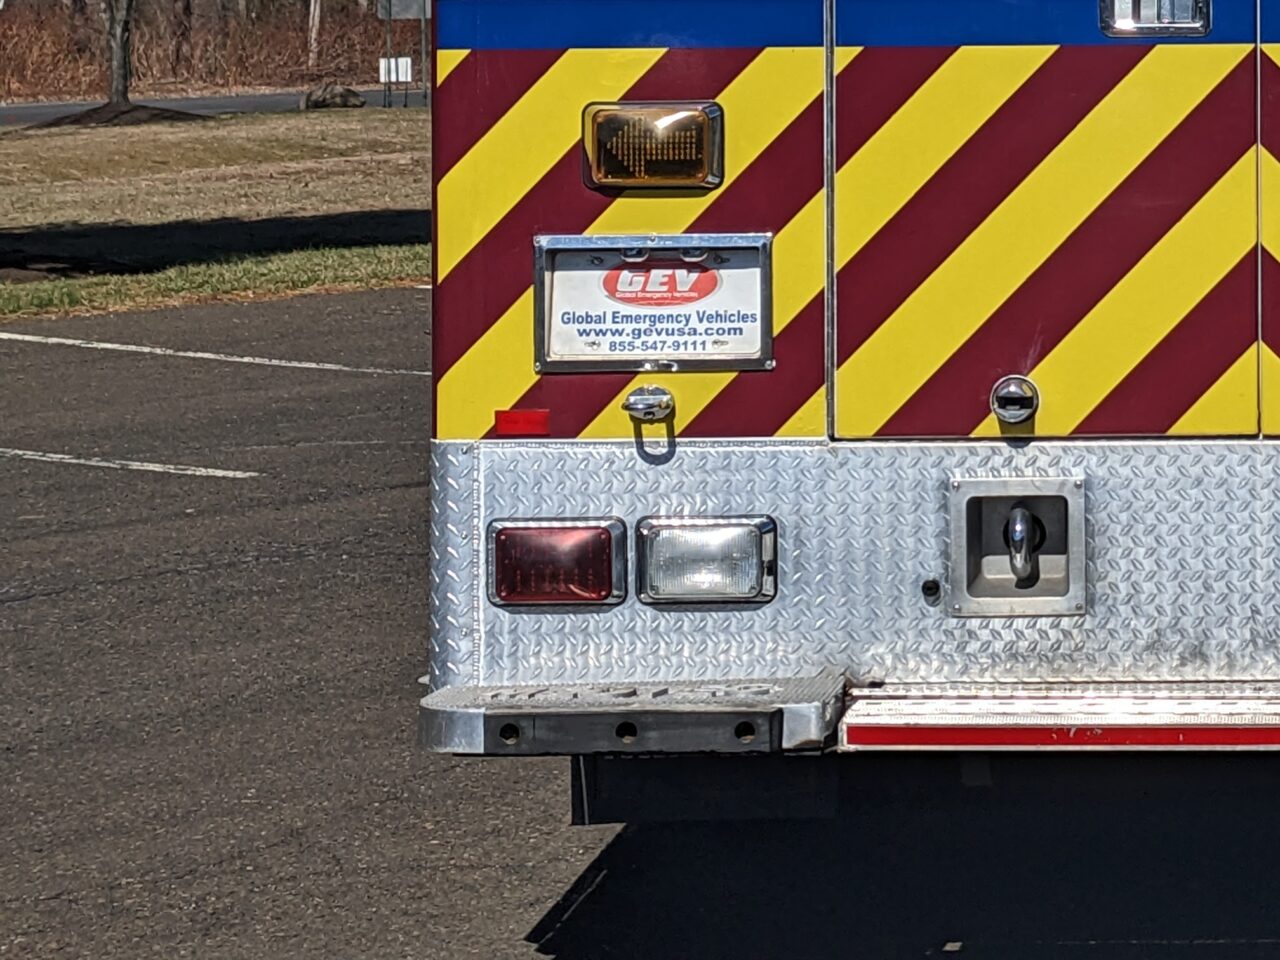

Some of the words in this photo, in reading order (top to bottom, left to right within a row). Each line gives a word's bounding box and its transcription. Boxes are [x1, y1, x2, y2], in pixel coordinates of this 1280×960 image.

[616, 268, 700, 291] GEV
[561, 310, 606, 325] Global
[611, 310, 691, 327] Emergency
[696, 309, 758, 324] Vehicles
[576, 326, 744, 339] www.gevusa.com
[608, 340, 706, 352] 855-547-9111
